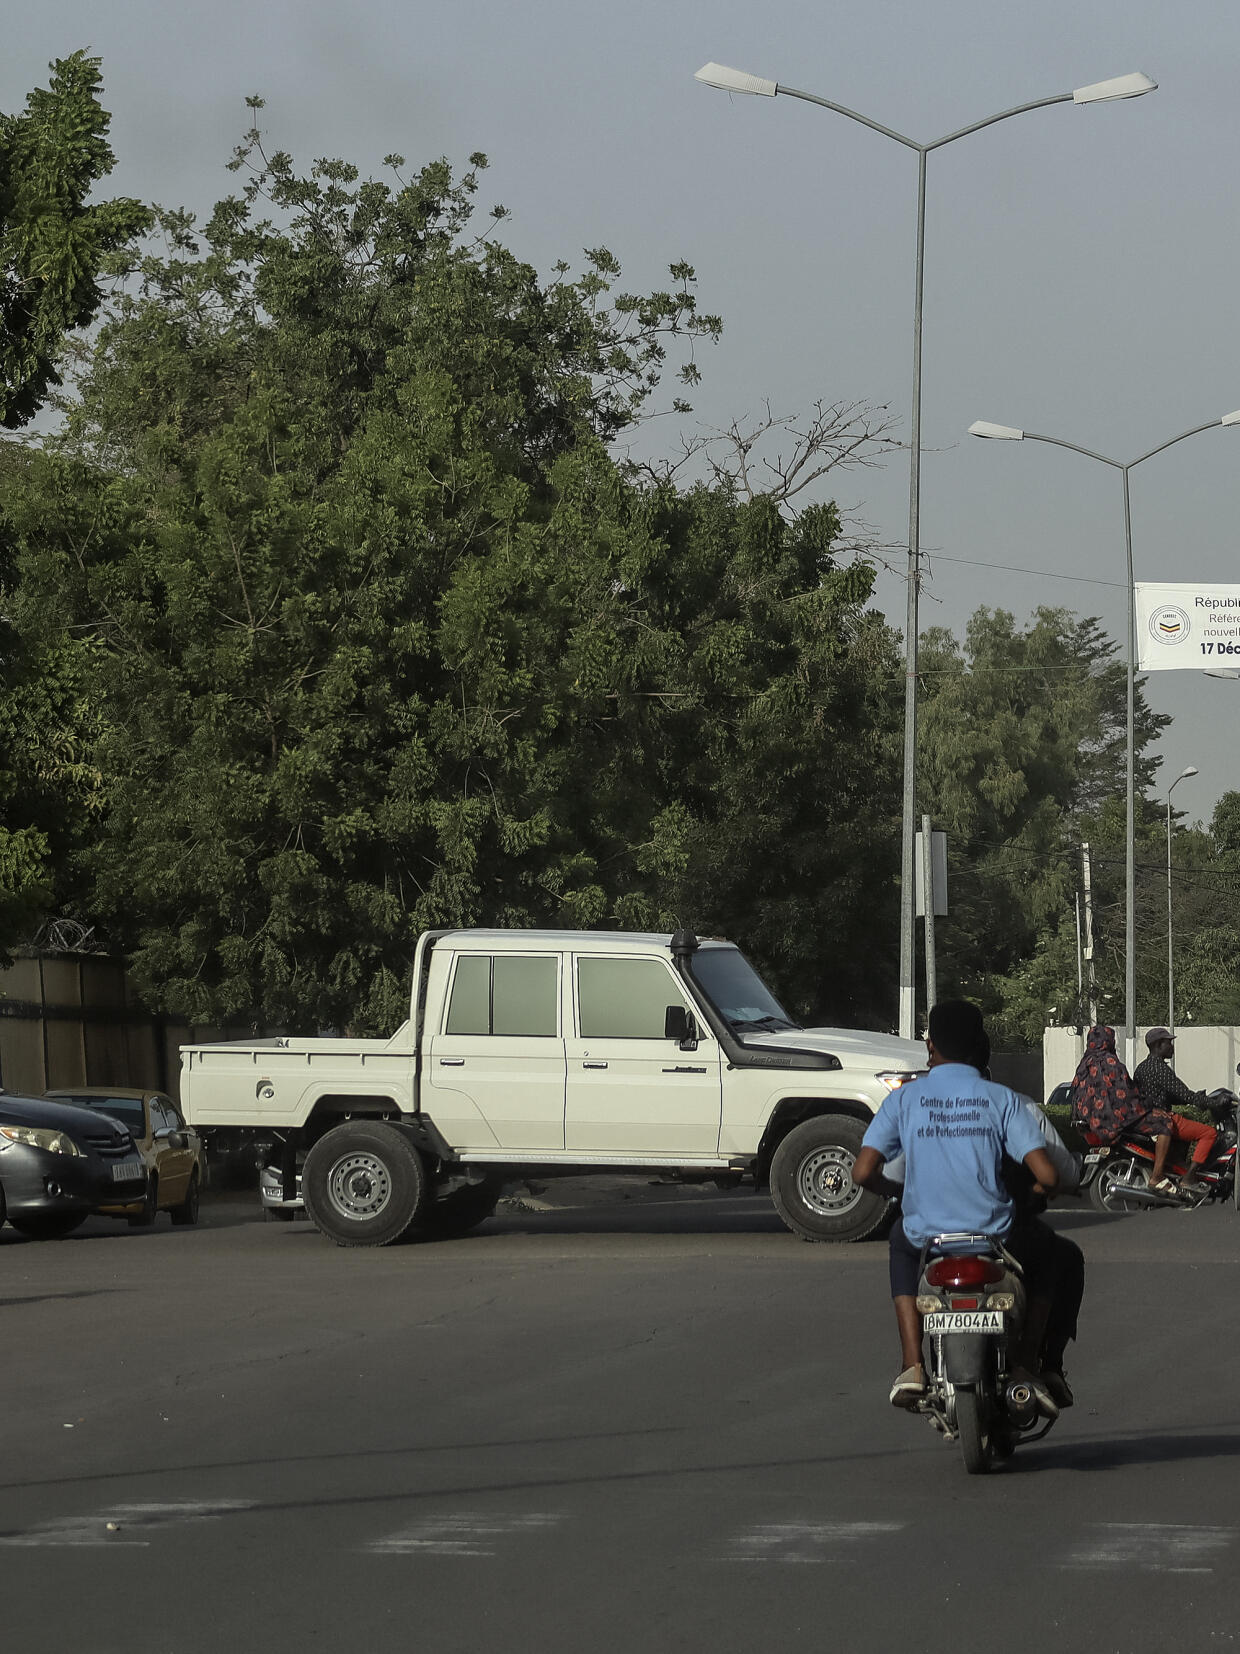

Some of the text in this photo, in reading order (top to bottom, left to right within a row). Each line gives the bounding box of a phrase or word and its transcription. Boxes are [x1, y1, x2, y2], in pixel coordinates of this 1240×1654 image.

[1200, 642, 1214, 655] 17
[920, 1095, 990, 1109] Centre de Formation
[929, 1109, 981, 1123] Professionnelle
[917, 1126, 925, 1137] et
[926, 1125, 935, 1137] de
